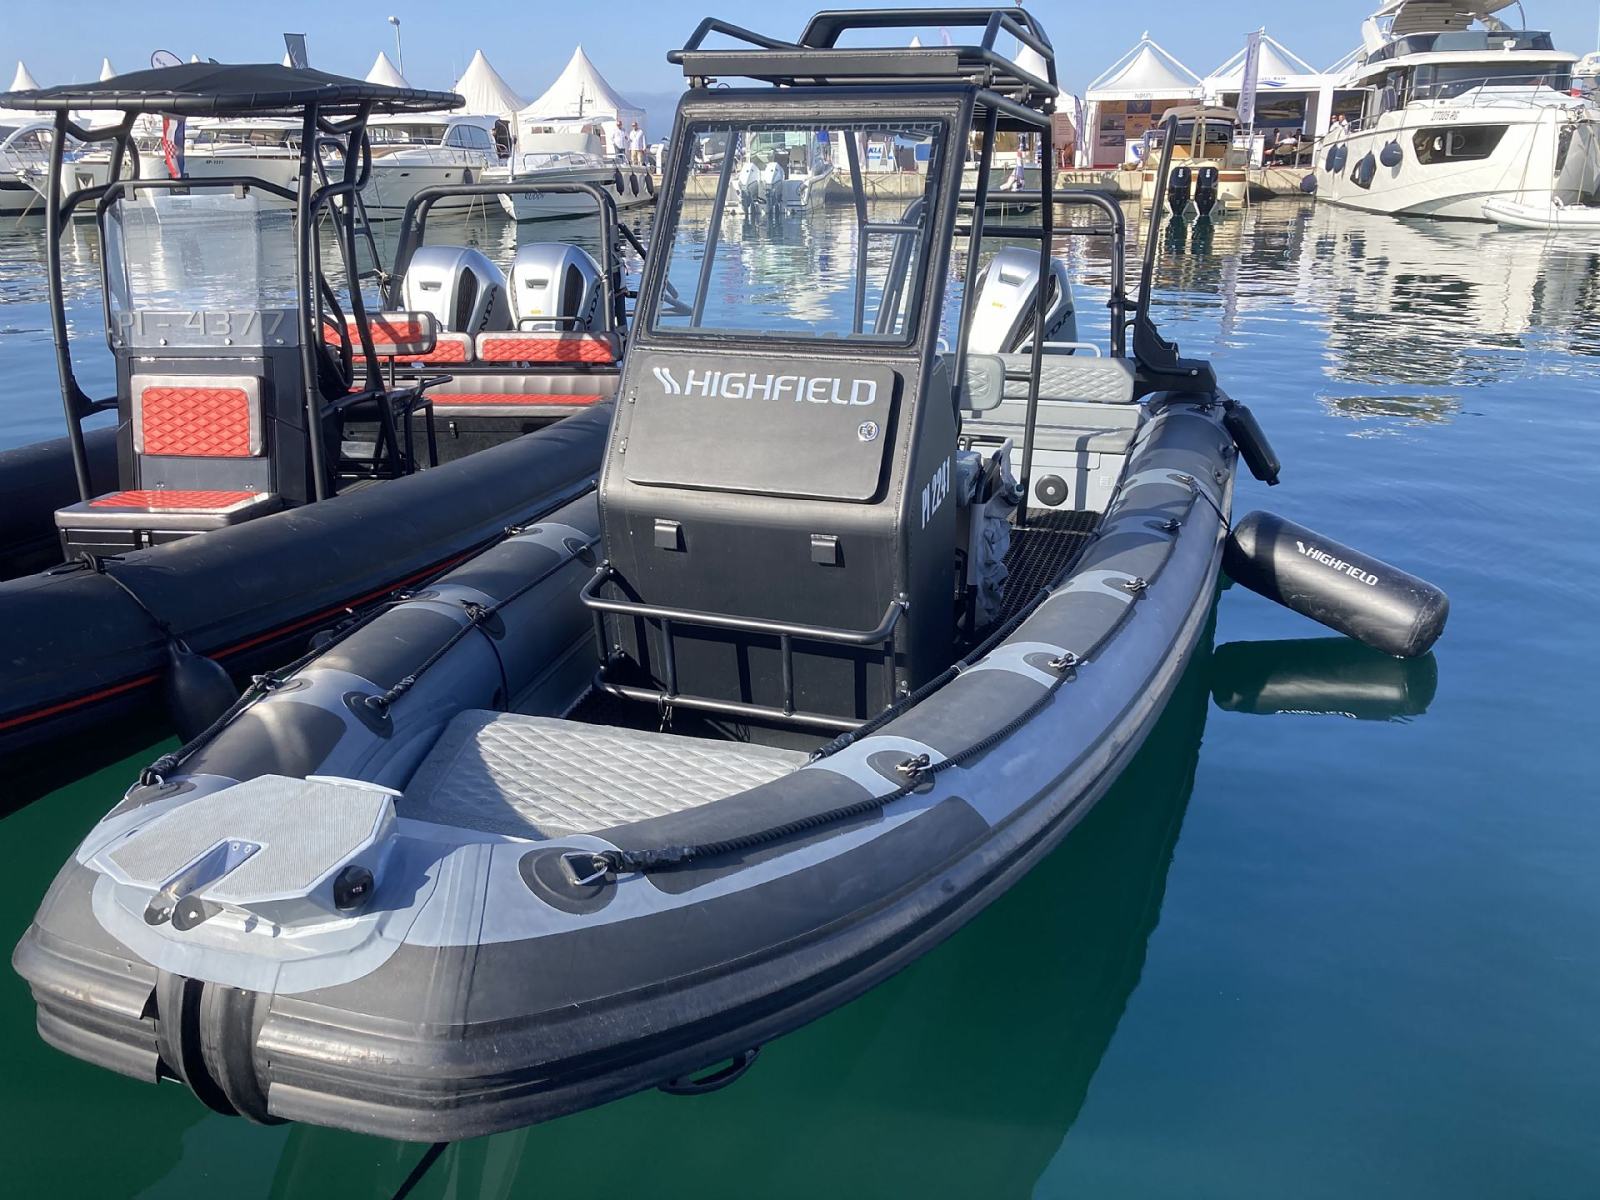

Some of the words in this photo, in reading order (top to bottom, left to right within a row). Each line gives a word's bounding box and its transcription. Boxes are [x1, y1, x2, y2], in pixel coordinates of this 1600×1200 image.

[183, 310, 286, 336] 4377
[684, 369, 878, 406] HIGHFIELD
[921, 482, 930, 530] PI
[931, 455, 951, 517] 2241
[1305, 547, 1379, 586] HIGHFIELD
